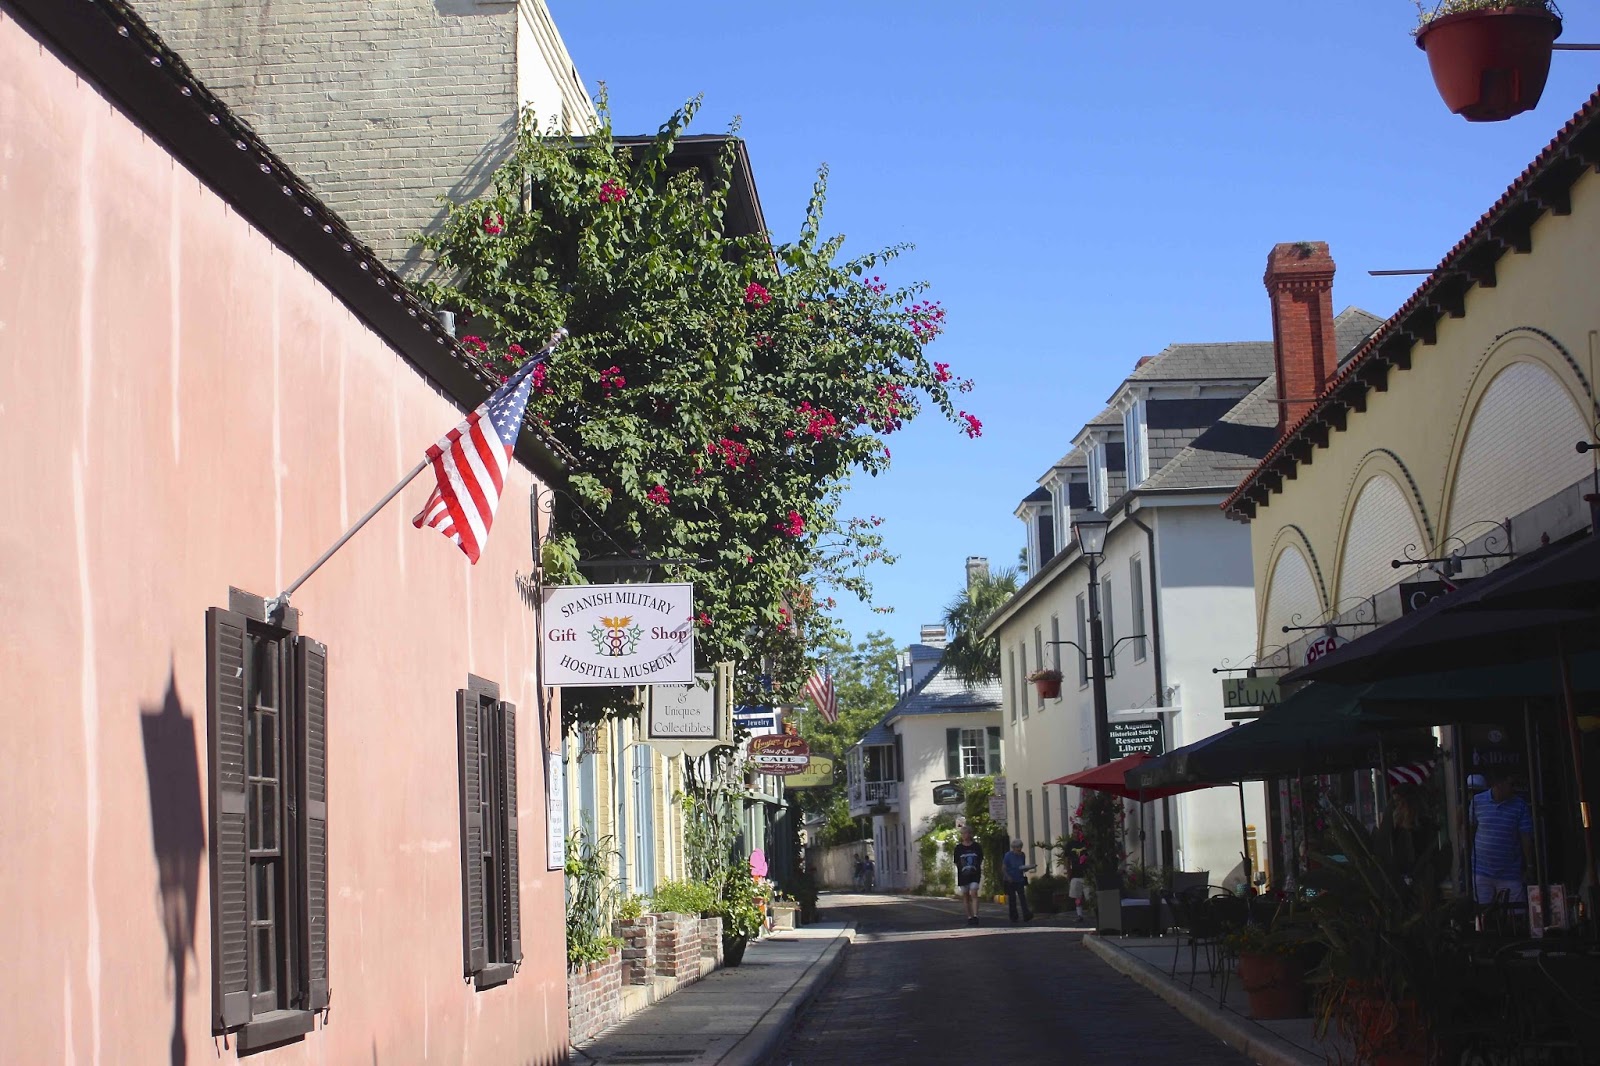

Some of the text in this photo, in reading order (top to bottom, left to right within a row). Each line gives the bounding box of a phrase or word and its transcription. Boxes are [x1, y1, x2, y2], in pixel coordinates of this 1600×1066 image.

[561, 591, 675, 618] SPANISH MILITARY
[548, 626, 687, 644] Gift Shop
[560, 652, 676, 679] HOSPITAL MUSEUM
[1228, 683, 1277, 706] PLUM
[664, 705, 701, 719] Uniques
[654, 722, 711, 733] Collectibles
[747, 719, 769, 727] Jewelry
[1115, 736, 1154, 745] Research
